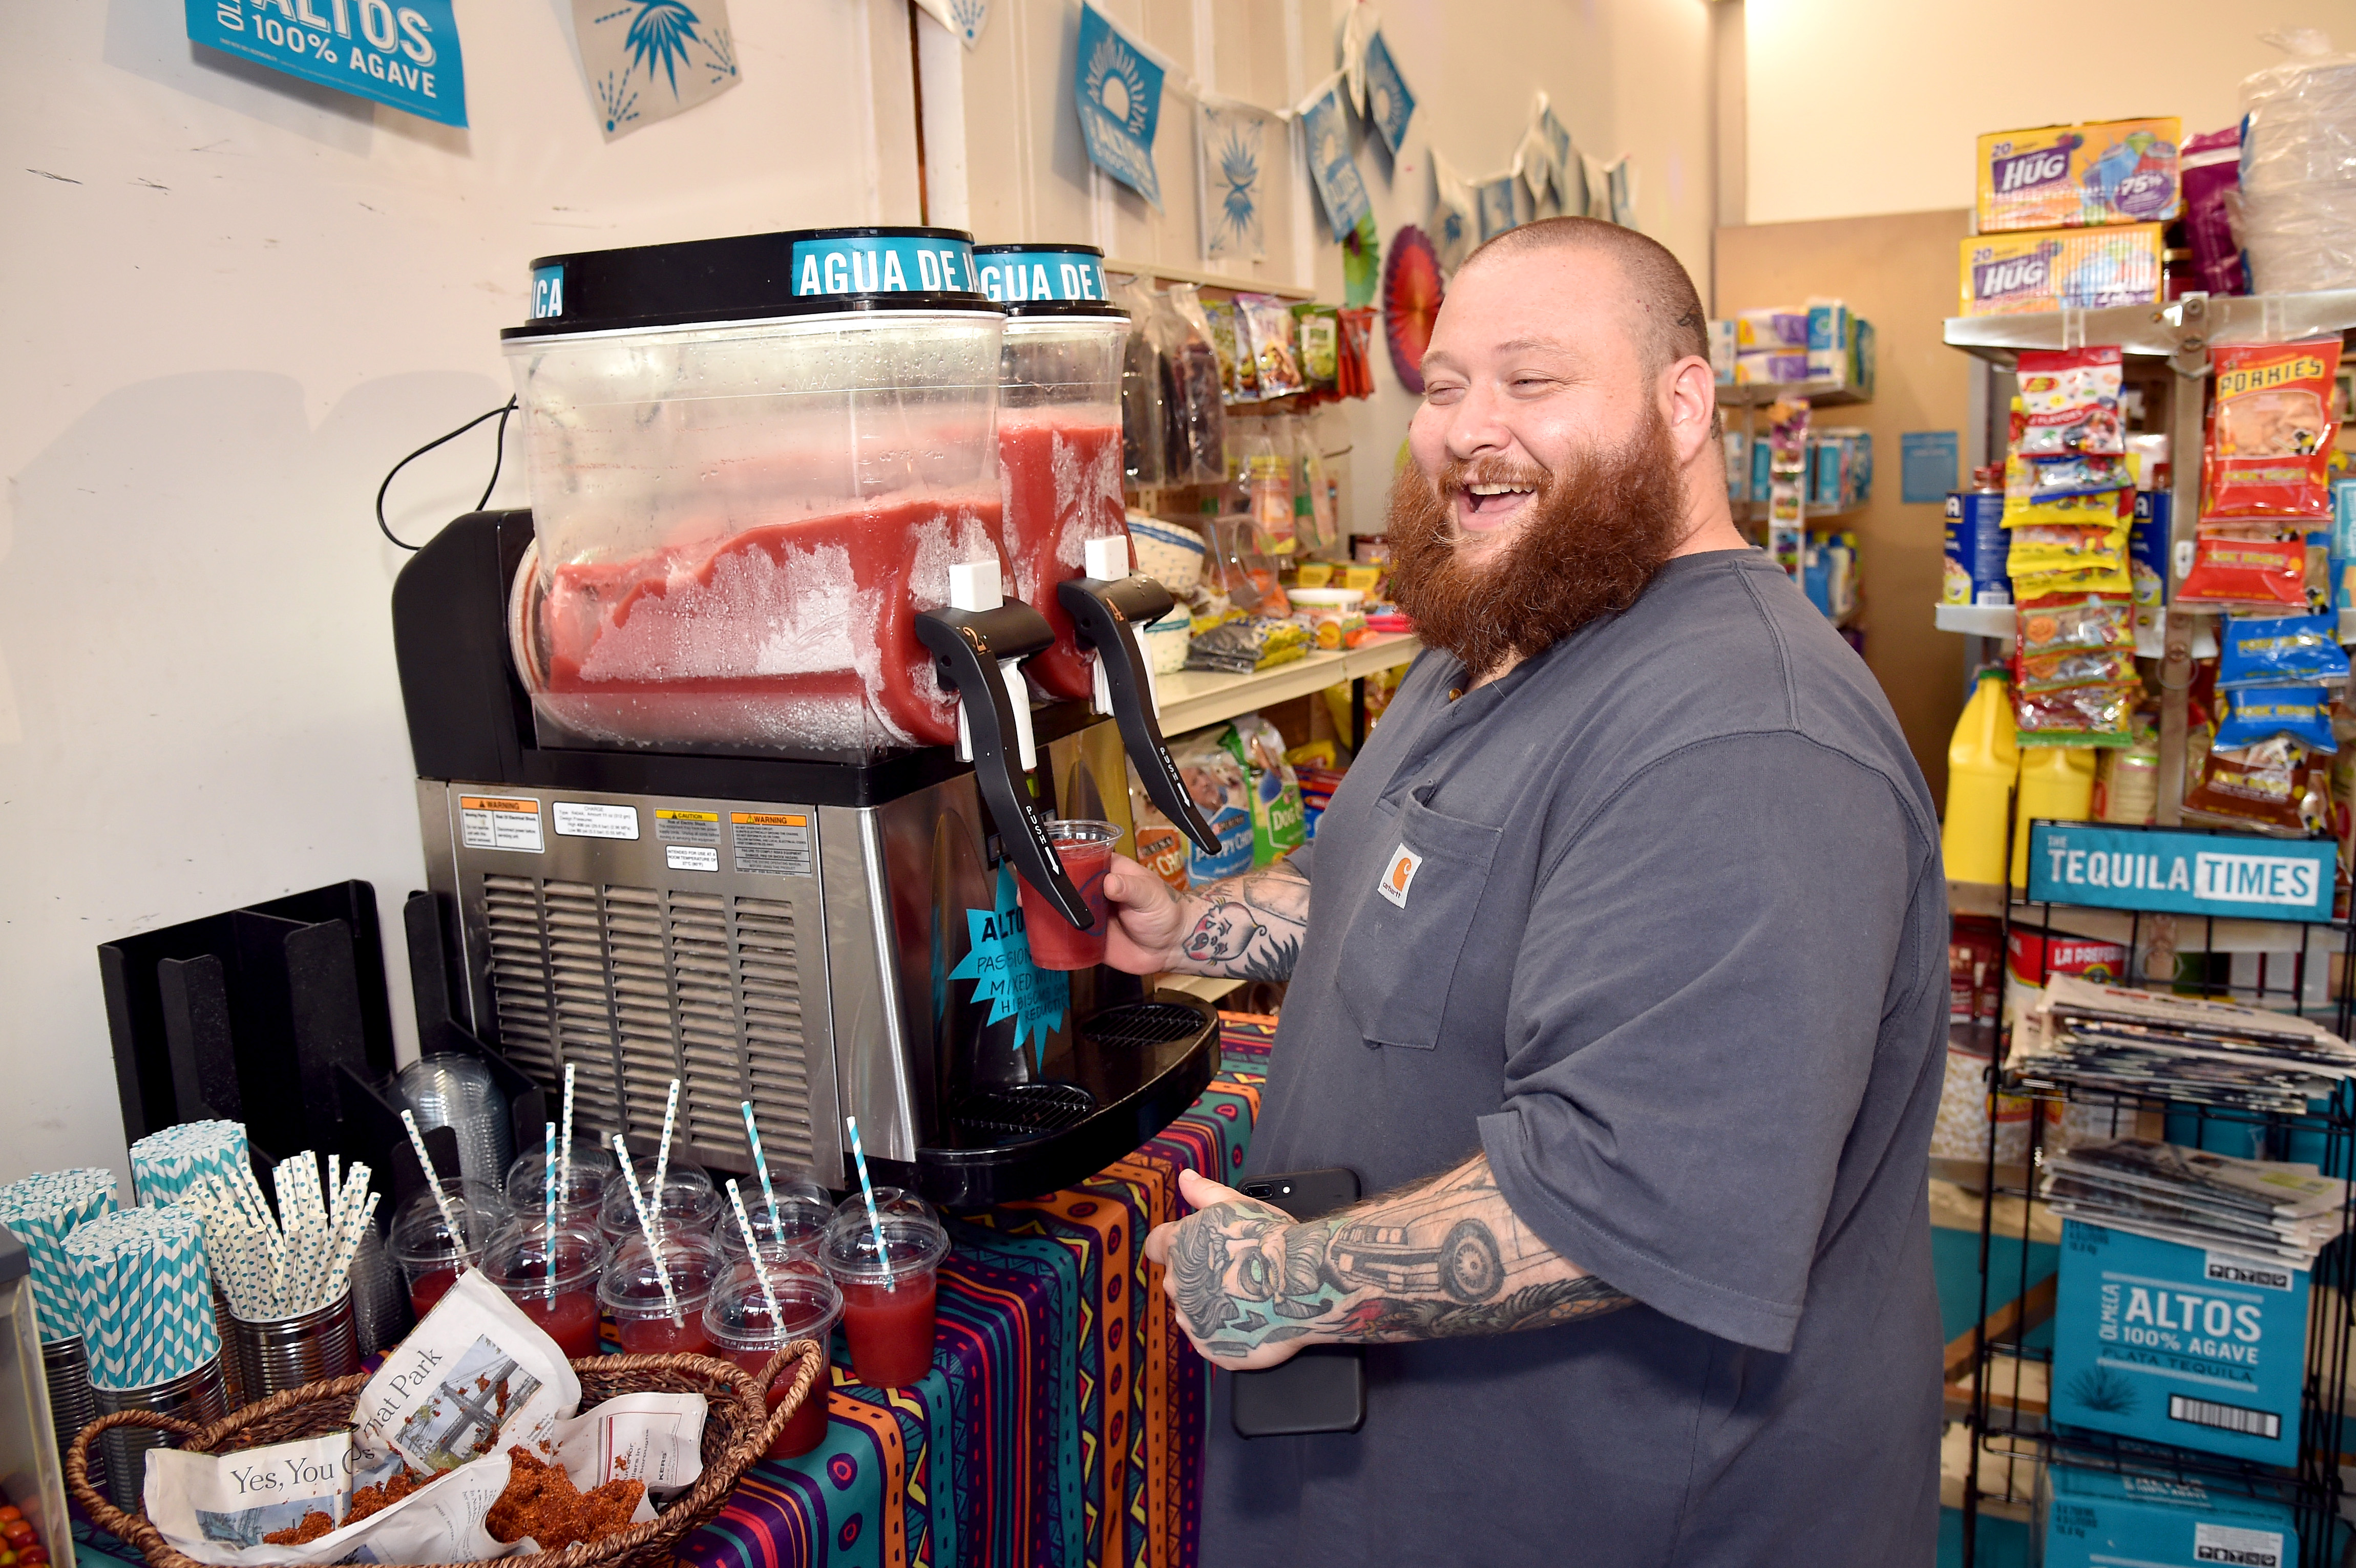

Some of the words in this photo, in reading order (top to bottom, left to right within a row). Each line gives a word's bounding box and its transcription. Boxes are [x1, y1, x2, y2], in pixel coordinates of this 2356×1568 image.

[251, 14, 338, 62] 100%
[349, 46, 437, 98] AGAVE
[2002, 154, 2065, 192] HUG
[800, 250, 909, 296] AGUA
[917, 250, 961, 292] DE
[980, 264, 1053, 302] GUA
[1060, 264, 1096, 301] DE
[1982, 261, 2044, 297] HUG
[2221, 360, 2321, 397] PORKIES
[1106, 598, 1125, 622] 4
[962, 626, 991, 655] 2
[1159, 746, 1180, 782] PUSH
[488, 801, 519, 810] WARNING
[1025, 805, 1048, 844] PUSH
[1382, 881, 1401, 899] carhartt
[2048, 849, 2190, 892] TEQUILA
[2204, 859, 2310, 898] TIMES
[981, 906, 1024, 942] ALTO
[2054, 947, 2073, 966] LA
[990, 972, 1032, 995] MIXED
[2099, 1284, 2121, 1341] OLMECA
[2126, 1287, 2262, 1343] ALTOS
[2123, 1326, 2182, 1351] 100%
[2188, 1337, 2260, 1365] AGAVE
[389, 1349, 443, 1400] Park
[2168, 1357, 2254, 1384] TEQUILA
[230, 1466, 285, 1494] Yes,
[284, 1457, 334, 1486] You
[659, 1452, 667, 1480] KERS
